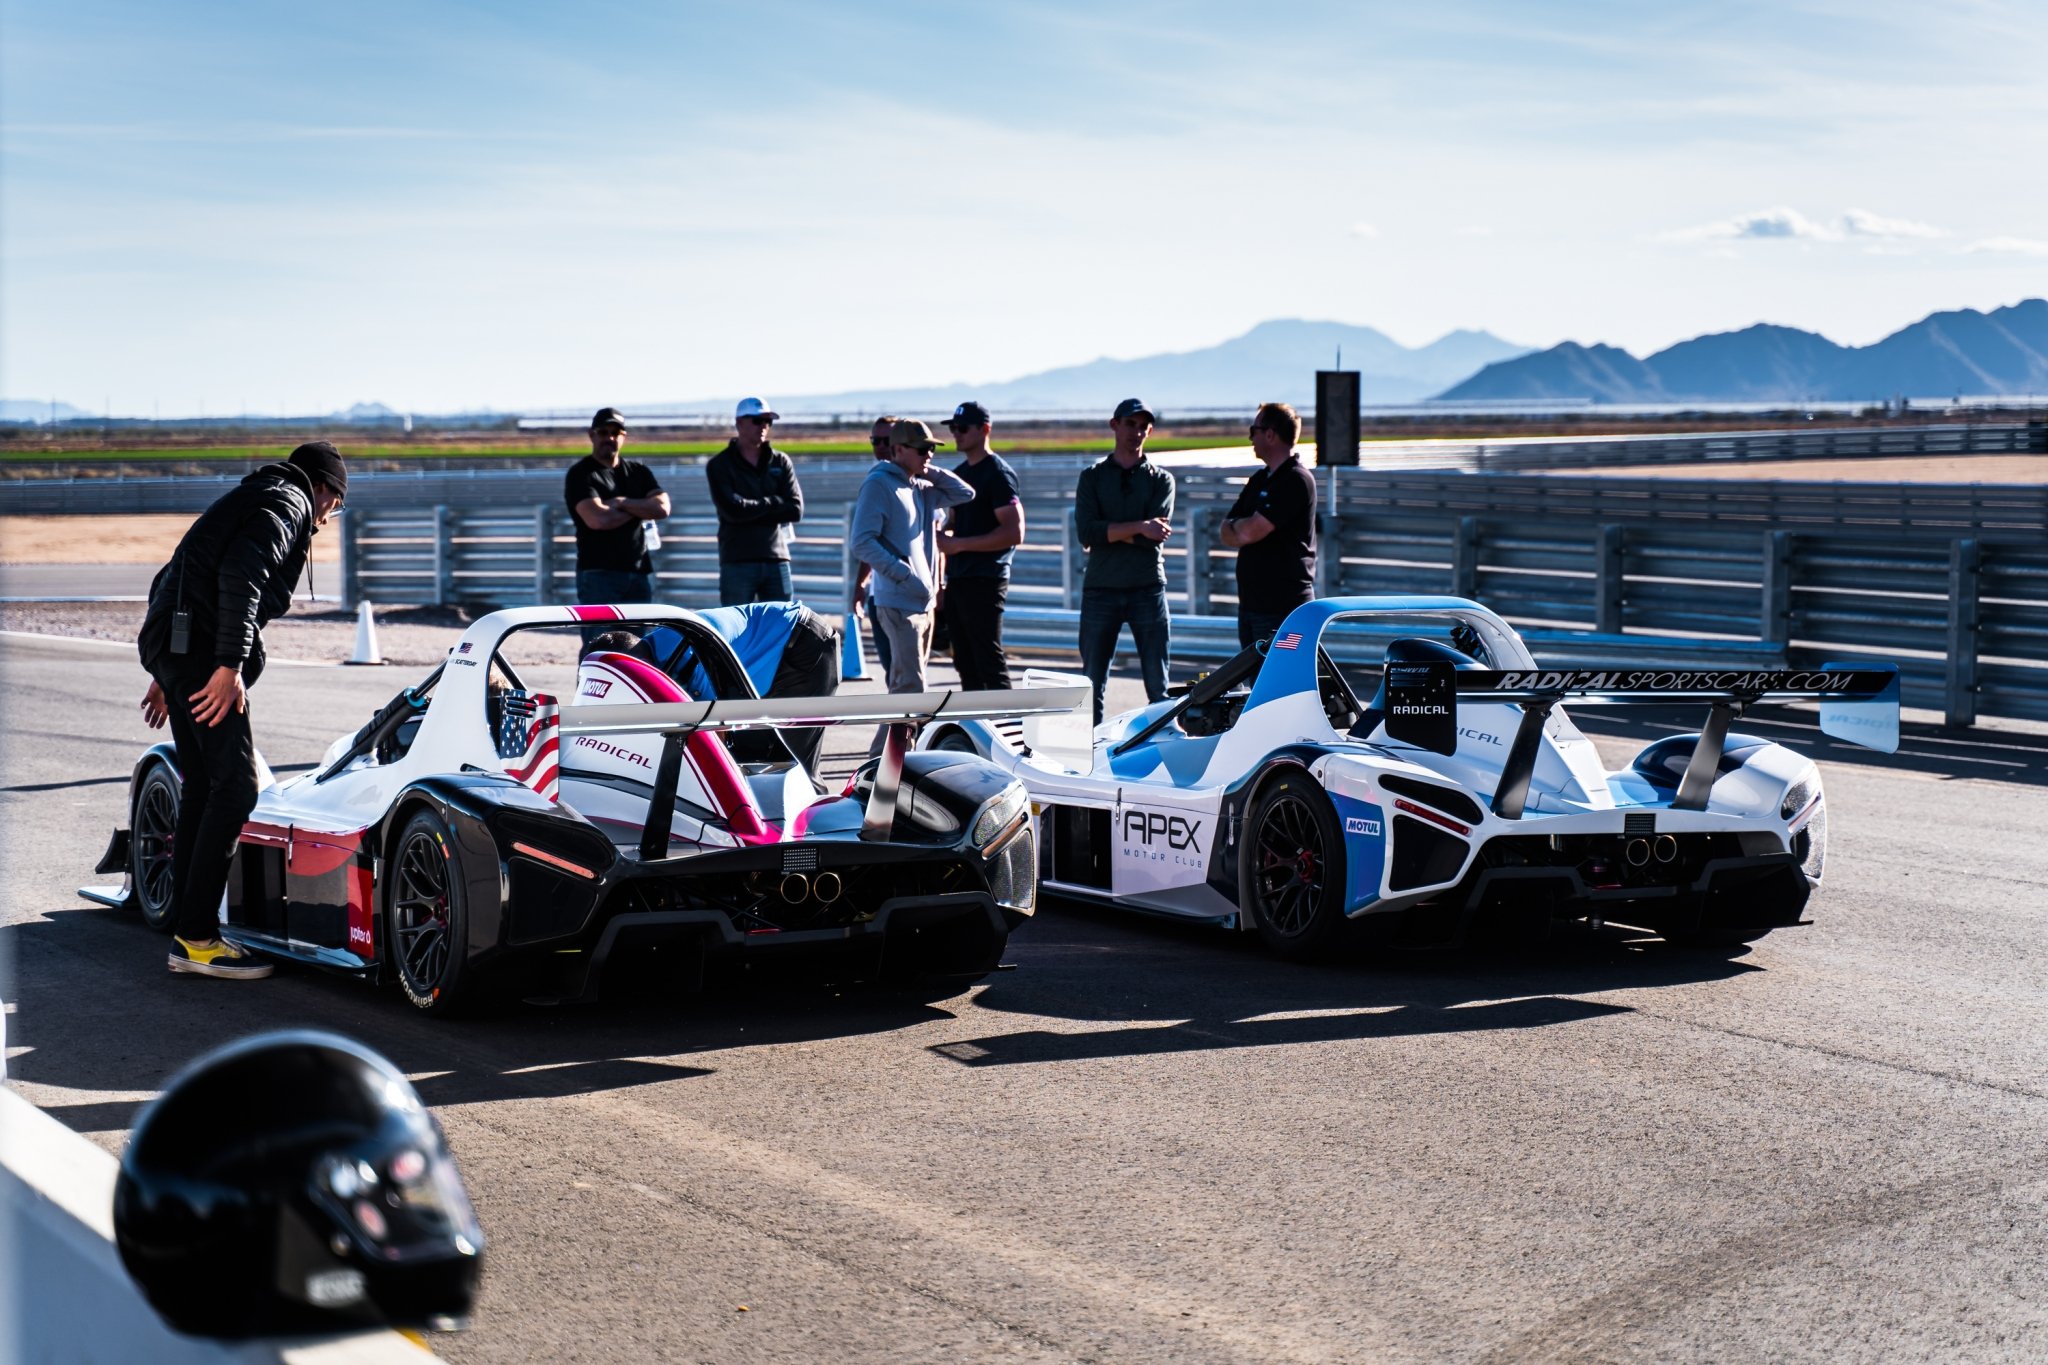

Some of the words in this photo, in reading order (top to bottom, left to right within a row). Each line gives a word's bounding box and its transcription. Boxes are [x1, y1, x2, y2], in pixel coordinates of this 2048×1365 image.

[583, 679, 609, 695] MOTUL
[1393, 705, 1449, 715] RADICAL
[1456, 726, 1503, 746] ICAL
[575, 736, 653, 769] RADICAL
[1124, 810, 1202, 854] APEX
[1348, 820, 1378, 834] MOTUL
[1124, 848, 1165, 861] MOTOR
[1175, 856, 1202, 868] CLUB
